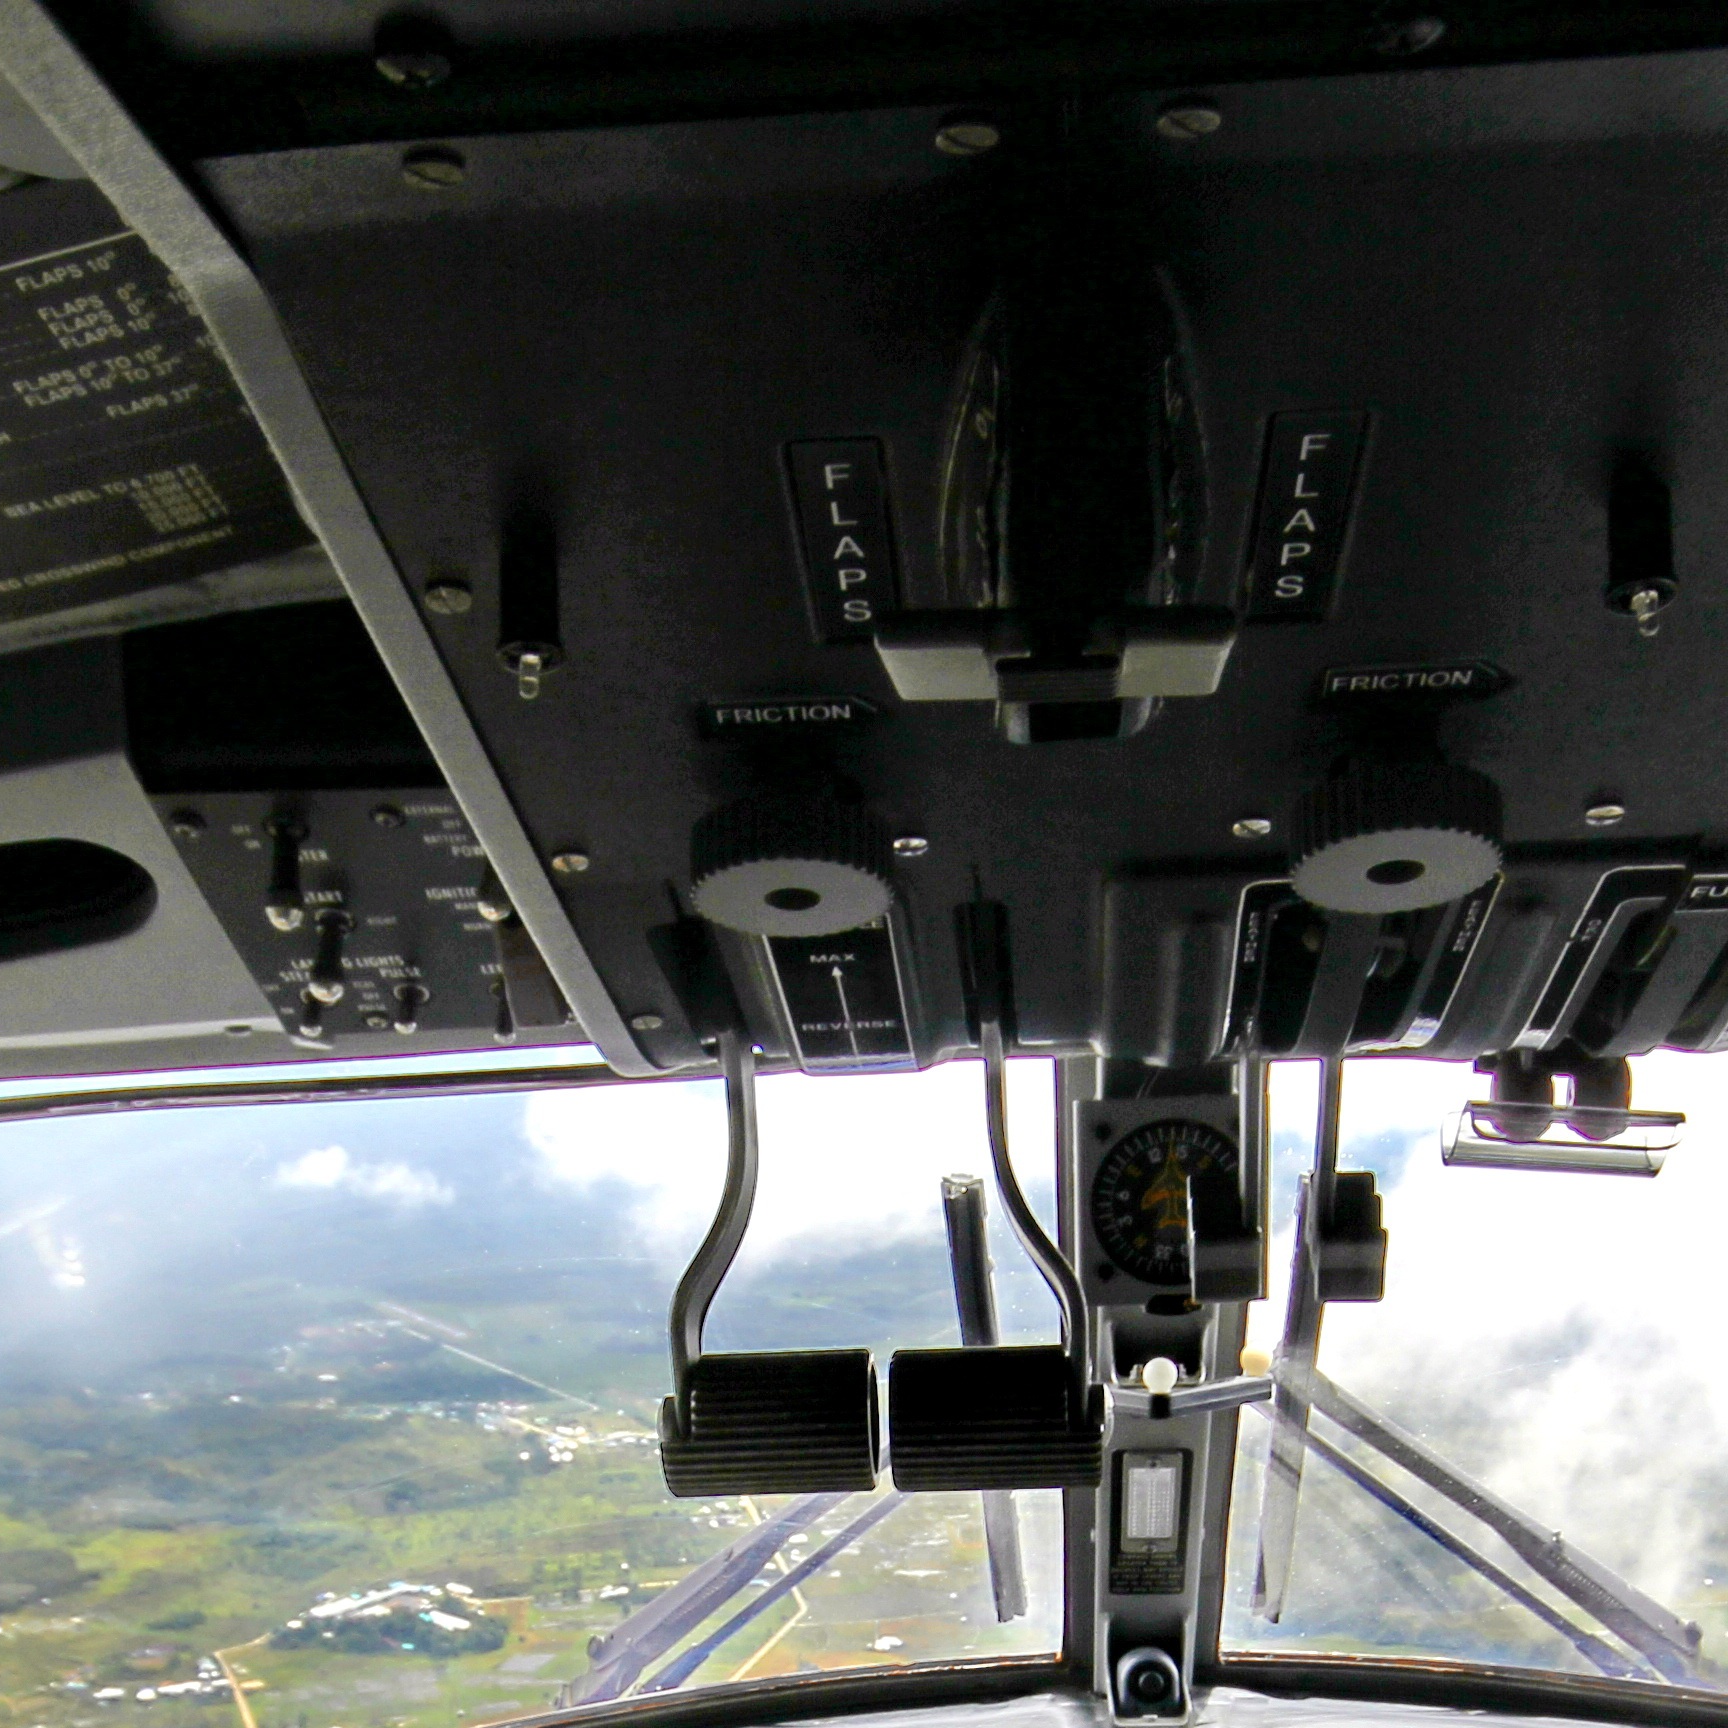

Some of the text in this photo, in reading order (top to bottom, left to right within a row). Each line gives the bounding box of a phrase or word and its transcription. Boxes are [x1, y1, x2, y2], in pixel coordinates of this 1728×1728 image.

[15, 265, 84, 292] FLAPS
[38, 295, 104, 320] FLAPS
[47, 311, 114, 336] FLAPS
[58, 326, 124, 350] FLAPS
[1271, 432, 1333, 600] FLAPS
[822, 462, 874, 624] FLAPS
[1330, 666, 1475, 695] FRICTION
[715, 703, 853, 726] FRICTION
[809, 953, 855, 963] MAX
[801, 1019, 896, 1031] REVERSE
